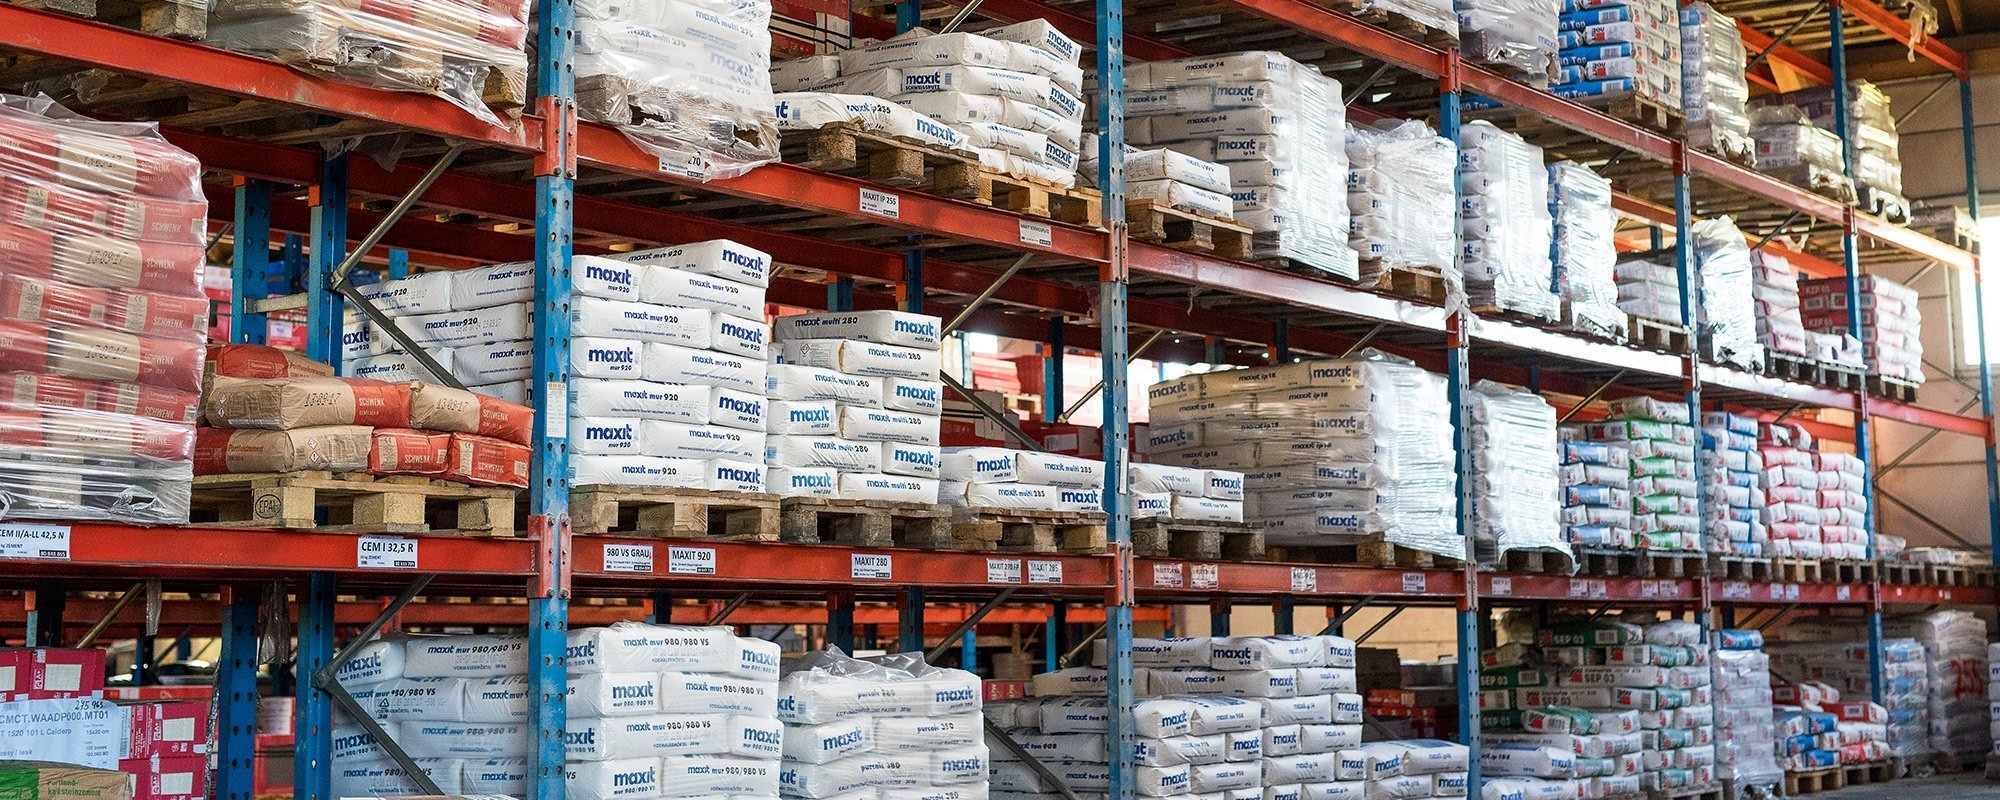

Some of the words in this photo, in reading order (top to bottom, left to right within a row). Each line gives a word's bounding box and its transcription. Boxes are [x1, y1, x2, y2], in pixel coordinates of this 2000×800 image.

[1048, 29, 1073, 54] maxit
[1185, 62, 1208, 70] maxit
[906, 72, 940, 85] maxit
[1216, 86, 1254, 97] maxit
[1050, 86, 1076, 112] maxit
[916, 118, 956, 144] maxit
[1046, 140, 1072, 164] maxit
[1218, 140, 1257, 150] maxit
[862, 191, 880, 203] MAXIT
[886, 196, 897, 206] 255
[152, 222, 183, 234] SCHWENK
[146, 258, 176, 271] SCHWENK
[722, 248, 764, 273] maxit
[586, 265, 632, 286] maxit
[153, 316, 184, 329] SCHWENK
[795, 318, 820, 327] maxit
[822, 318, 841, 326] multi
[842, 316, 858, 325] 280
[894, 319, 934, 337] maxit
[720, 322, 762, 344] maxit
[144, 352, 174, 366] SCHWENK
[588, 346, 633, 363] maxit
[868, 347, 890, 357] maxit
[908, 352, 922, 361] 280
[1313, 366, 1352, 378] maxit
[896, 384, 936, 402] maxit
[1149, 382, 1186, 400] maxit
[359, 396, 386, 408] SCHWENK
[718, 396, 761, 416] maxit
[145, 406, 175, 420] SCHWENK
[483, 408, 510, 422] SCHWENK
[790, 407, 830, 423] maxit
[868, 412, 890, 422] maxit
[908, 417, 922, 425] 280
[1315, 417, 1356, 429] maxit
[586, 424, 632, 440] maxit
[1149, 431, 1186, 446] maxit
[405, 454, 430, 465] SCHWENK
[894, 448, 934, 466] maxit
[976, 456, 1012, 472] maxit
[478, 460, 505, 474] SCHWENK
[622, 465, 646, 474] maxit
[662, 468, 677, 476] 920
[1318, 467, 1358, 480] maxit
[718, 466, 761, 485] maxit
[792, 472, 832, 488] maxit
[866, 479, 890, 488] maxit
[1210, 476, 1241, 490] maxit
[998, 488, 1018, 497] maxit
[1061, 489, 1100, 504] maxit
[1138, 498, 1168, 510] maxit
[1318, 514, 1358, 528] maxit
[0, 530, 13, 538] EM
[41, 531, 56, 540] 42,5
[362, 542, 380, 552] CEM
[383, 542, 385, 552] I
[388, 543, 405, 554] 32,5
[408, 544, 413, 552] R
[607, 548, 619, 556] 980
[672, 550, 696, 560] MAXIT
[698, 552, 711, 560] 920
[855, 557, 875, 566] MAXIT
[876, 558, 887, 566] 280
[989, 562, 1004, 570] MAXIT
[1030, 563, 1046, 572] MAXIT
[623, 637, 648, 646] maxit
[664, 637, 698, 646] 980/980
[700, 638, 709, 646] VS
[428, 645, 455, 654] maxit
[472, 644, 508, 653] 980/980
[1213, 646, 1251, 660] maxit
[1330, 645, 1354, 657] maxit
[742, 647, 778, 666] maxit
[686, 681, 709, 692] maxit
[723, 685, 755, 694] 980/980
[756, 687, 764, 695] VS
[1269, 676, 1295, 687] maxit
[612, 681, 654, 699] maxit
[936, 686, 974, 703] maxit
[1337, 700, 1361, 714] maxit
[626, 722, 651, 732] maxit
[667, 721, 700, 731] 980/980
[1162, 712, 1188, 728] maxit
[422, 726, 448, 736] maxit
[466, 726, 505, 735] 980/980
[508, 726, 518, 734] VS
[744, 726, 780, 745] maxit
[823, 727, 863, 751] maxit
[1234, 738, 1260, 752] maxit
[1273, 734, 1297, 746] maxit
[942, 756, 981, 772] maxit
[614, 767, 656, 786] maxit
[725, 767, 757, 776] 980/980
[1162, 772, 1188, 787] maxit
[1438, 776, 1464, 788] maxit
